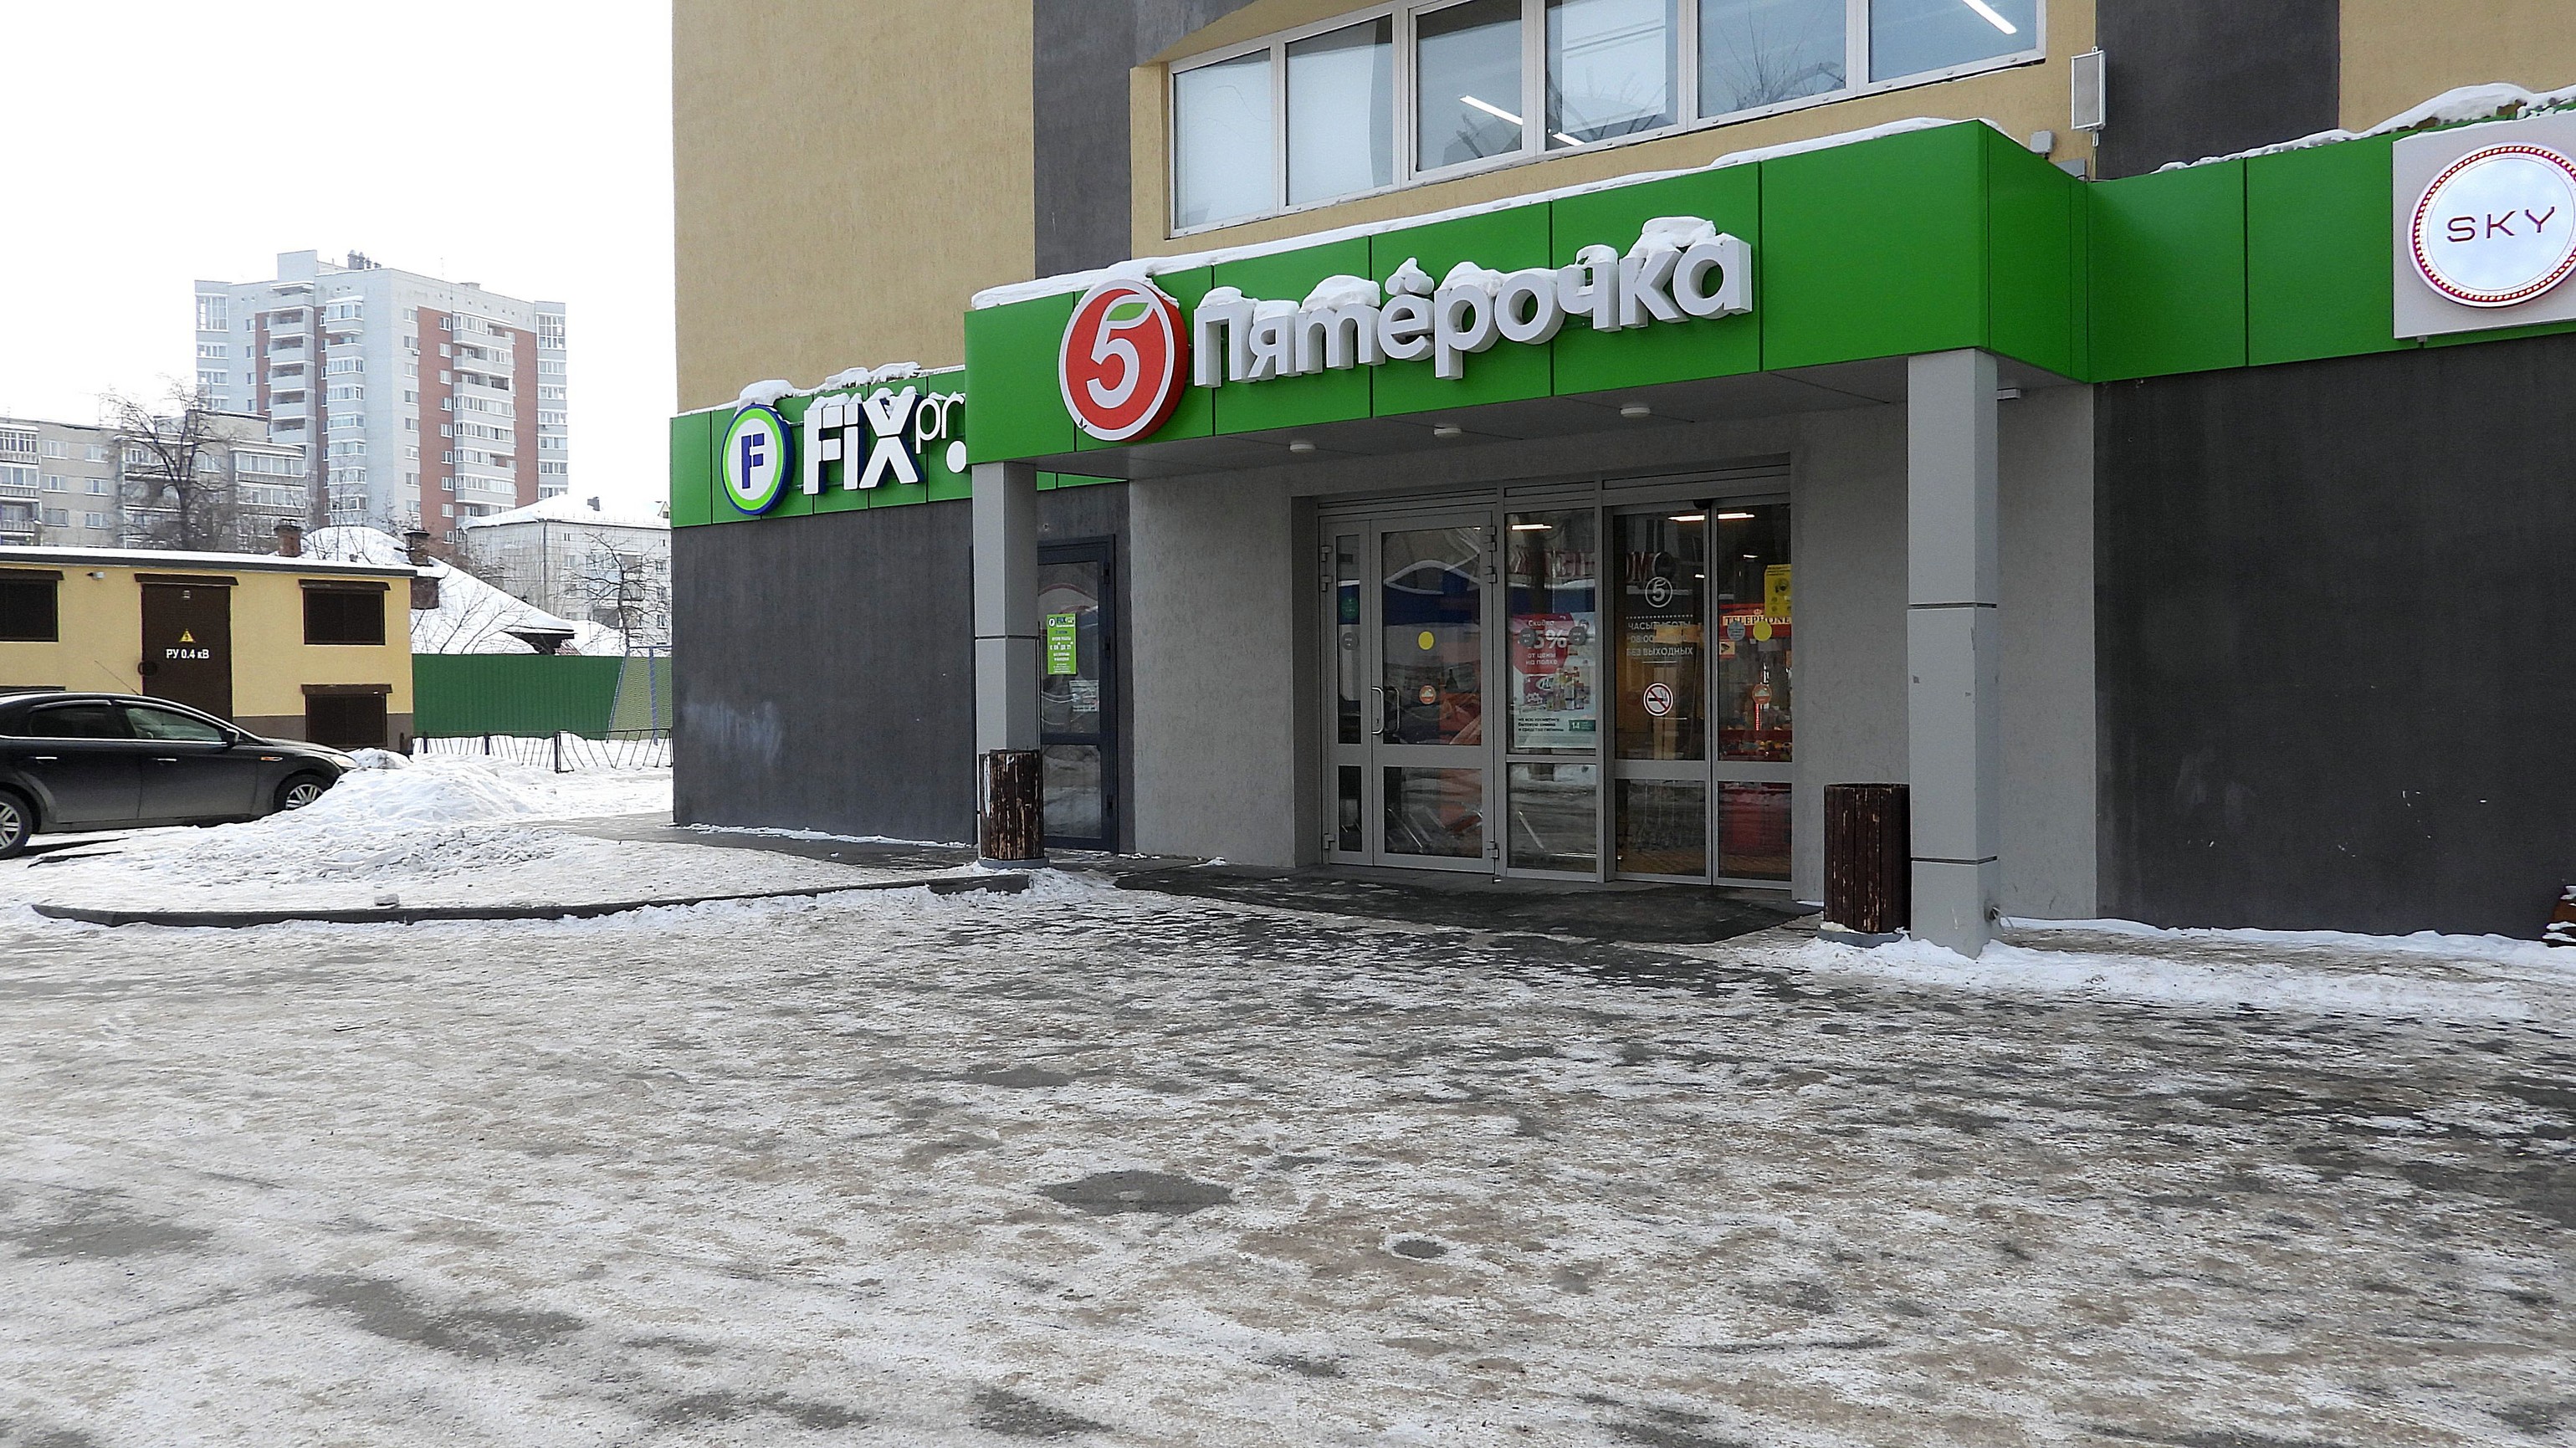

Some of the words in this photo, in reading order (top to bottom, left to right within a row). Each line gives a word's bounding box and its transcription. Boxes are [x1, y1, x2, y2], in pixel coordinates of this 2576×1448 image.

[2446, 206, 2555, 243] SKY
[1193, 231, 1752, 388] Пятёрочка
[1627, 622, 1654, 630] ЧАСЫ
[166, 649, 179, 659] РУ
[181, 649, 196, 659] 0.4
[197, 649, 210, 659] кВ
[1643, 647, 1693, 657] ВЫХОДНЫХ
